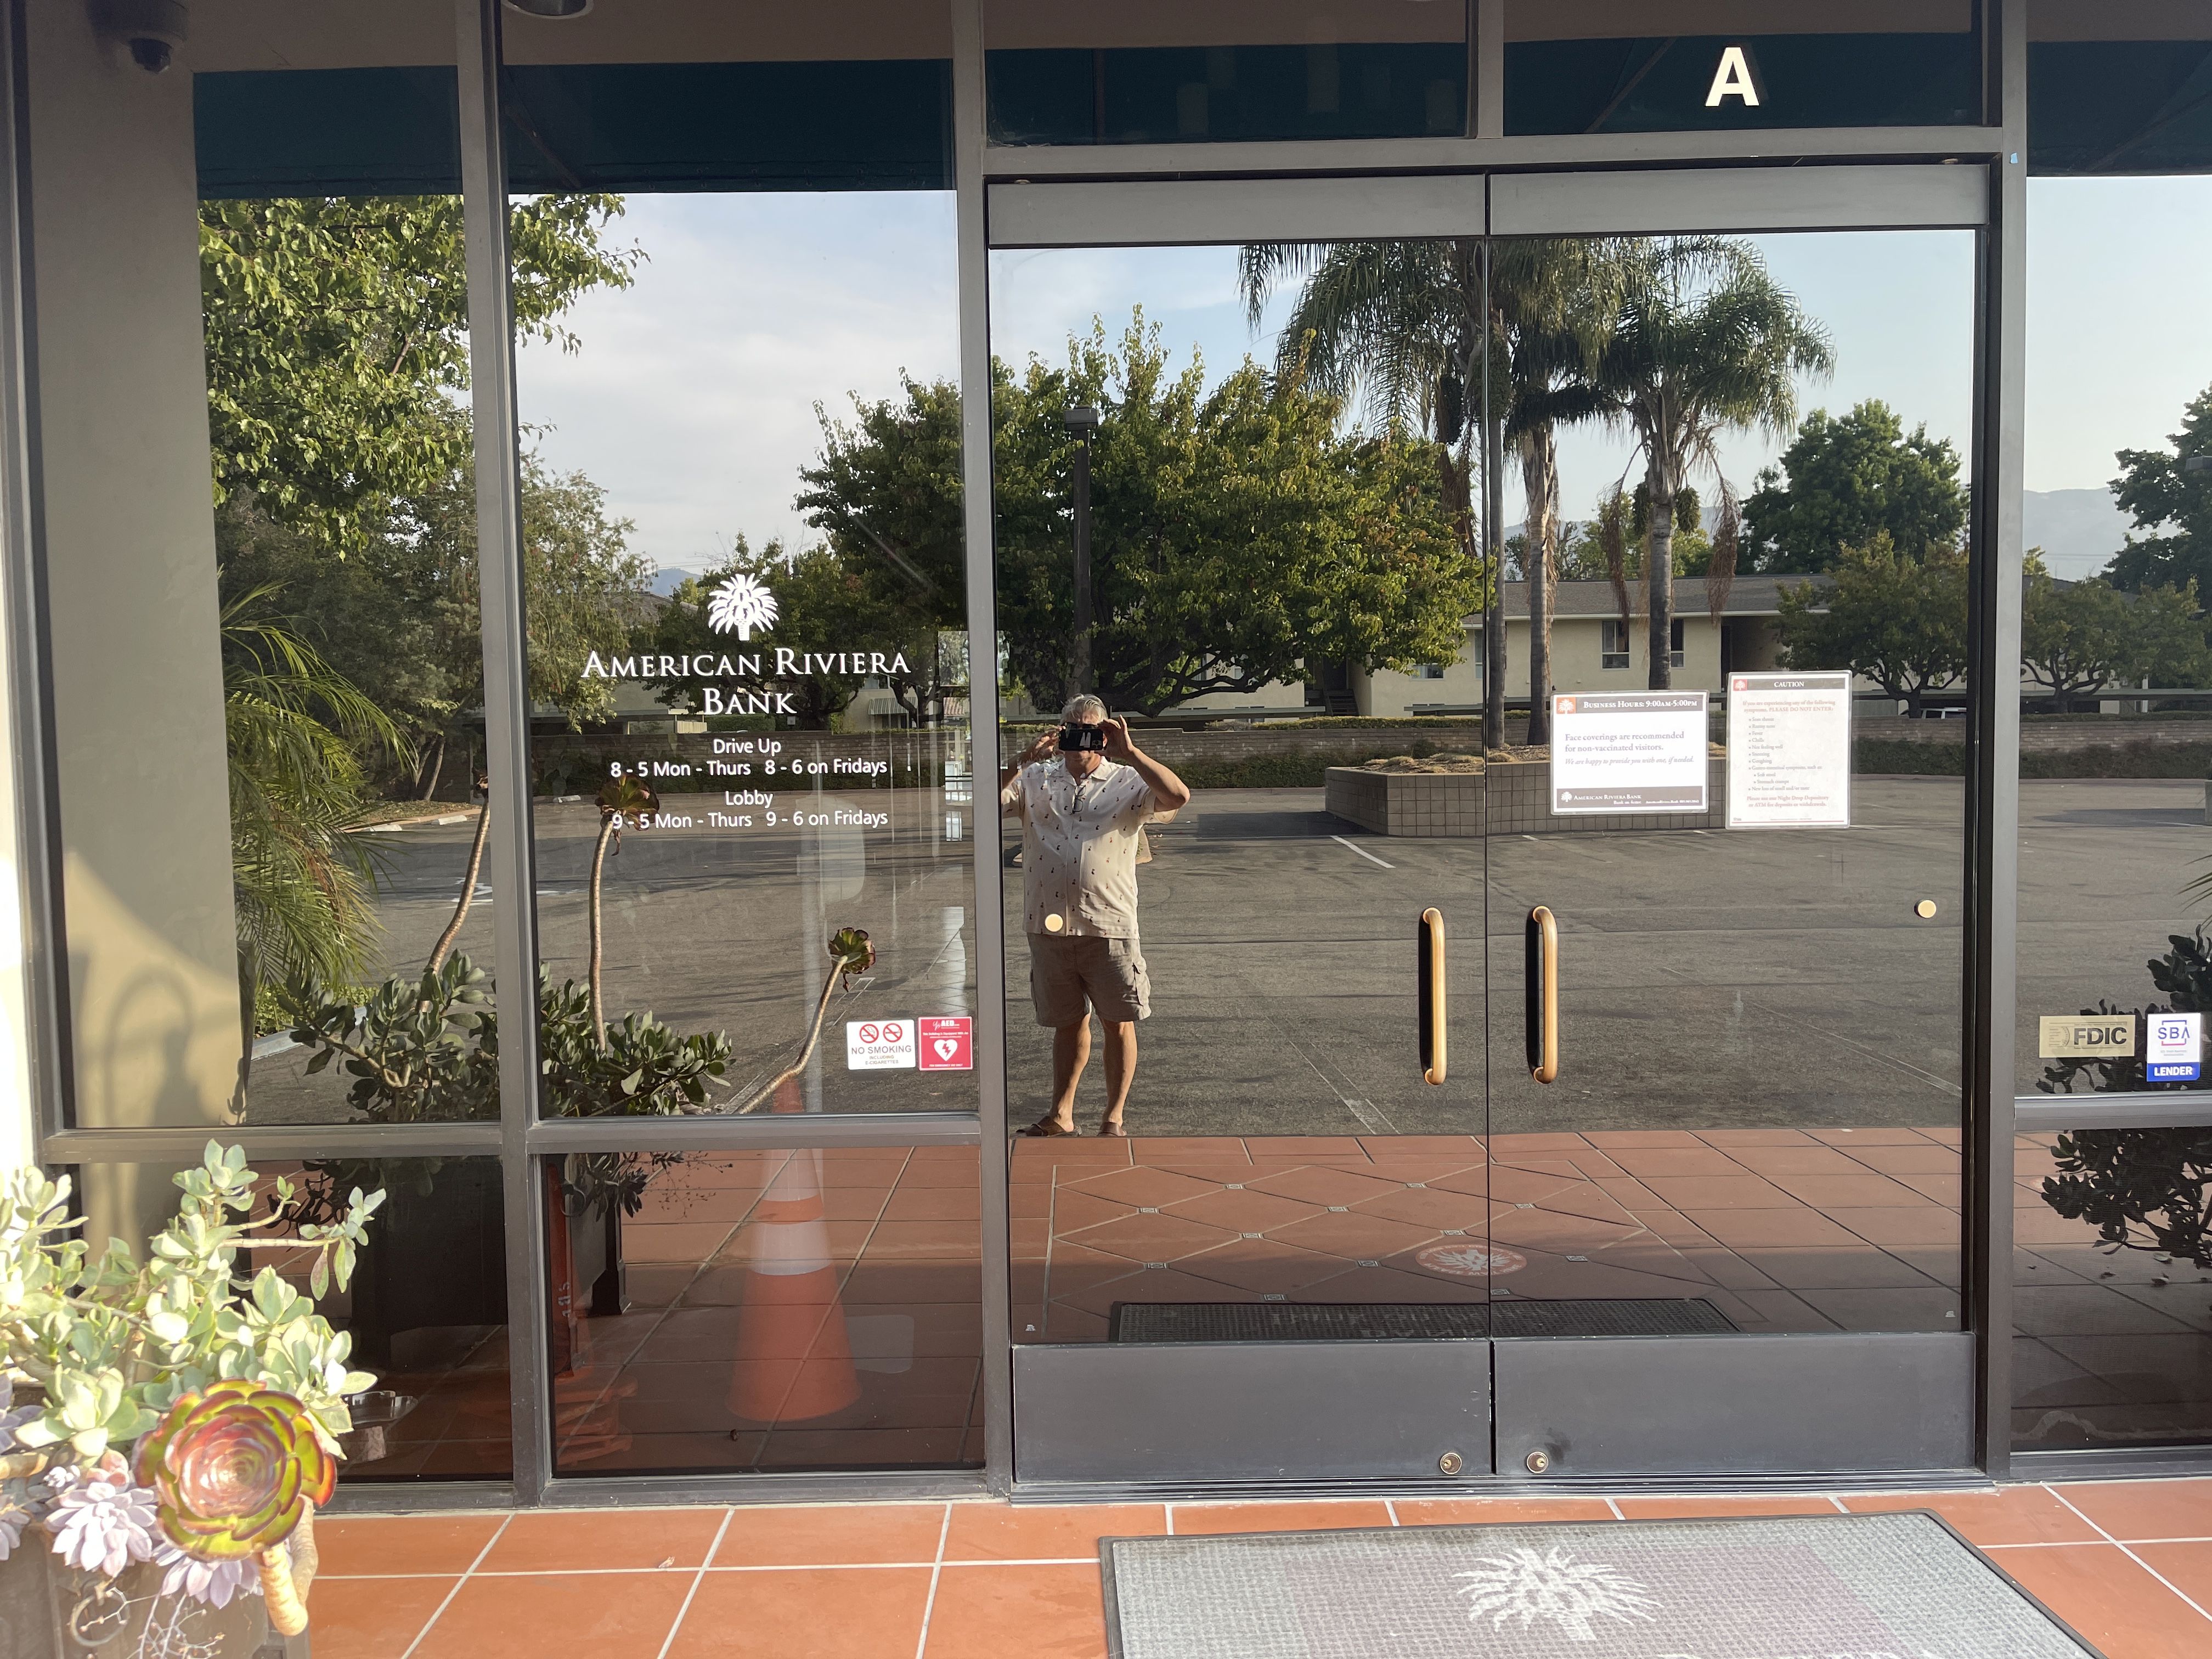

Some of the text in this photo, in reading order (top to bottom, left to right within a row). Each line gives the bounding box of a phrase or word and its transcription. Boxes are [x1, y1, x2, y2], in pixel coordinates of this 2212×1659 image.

[1705, 47, 1759, 106] A
[580, 648, 911, 678] AMERICAN RIVIERA
[702, 687, 797, 715] BANK
[1583, 733, 1618, 742] coverings
[1632, 731, 1684, 740] recommended
[714, 738, 781, 757] Drive Up
[1565, 744, 1576, 752] for
[1577, 743, 1633, 752] non-vaccinated
[611, 762, 622, 777] 8
[639, 762, 648, 777] 5
[654, 761, 691, 776] Mon
[706, 760, 751, 776] Thurs
[765, 760, 776, 775] 8
[792, 759, 803, 774] 6
[808, 762, 828, 774] on
[834, 758, 887, 777] Fridays
[725, 789, 774, 809] Lobby
[612, 814, 623, 829] 9
[640, 814, 650, 829] 5
[655, 813, 692, 828] Mon
[707, 811, 752, 827] Thurs
[766, 811, 776, 826] 9
[793, 811, 804, 826] 6
[808, 814, 829, 826] on
[834, 809, 888, 828] Fridays
[2074, 1026, 2127, 1046] FDIC
[2158, 1026, 2190, 1040] SBA
[867, 1045, 912, 1054] SMOKING
[2154, 1066, 2193, 1076] LENDER
